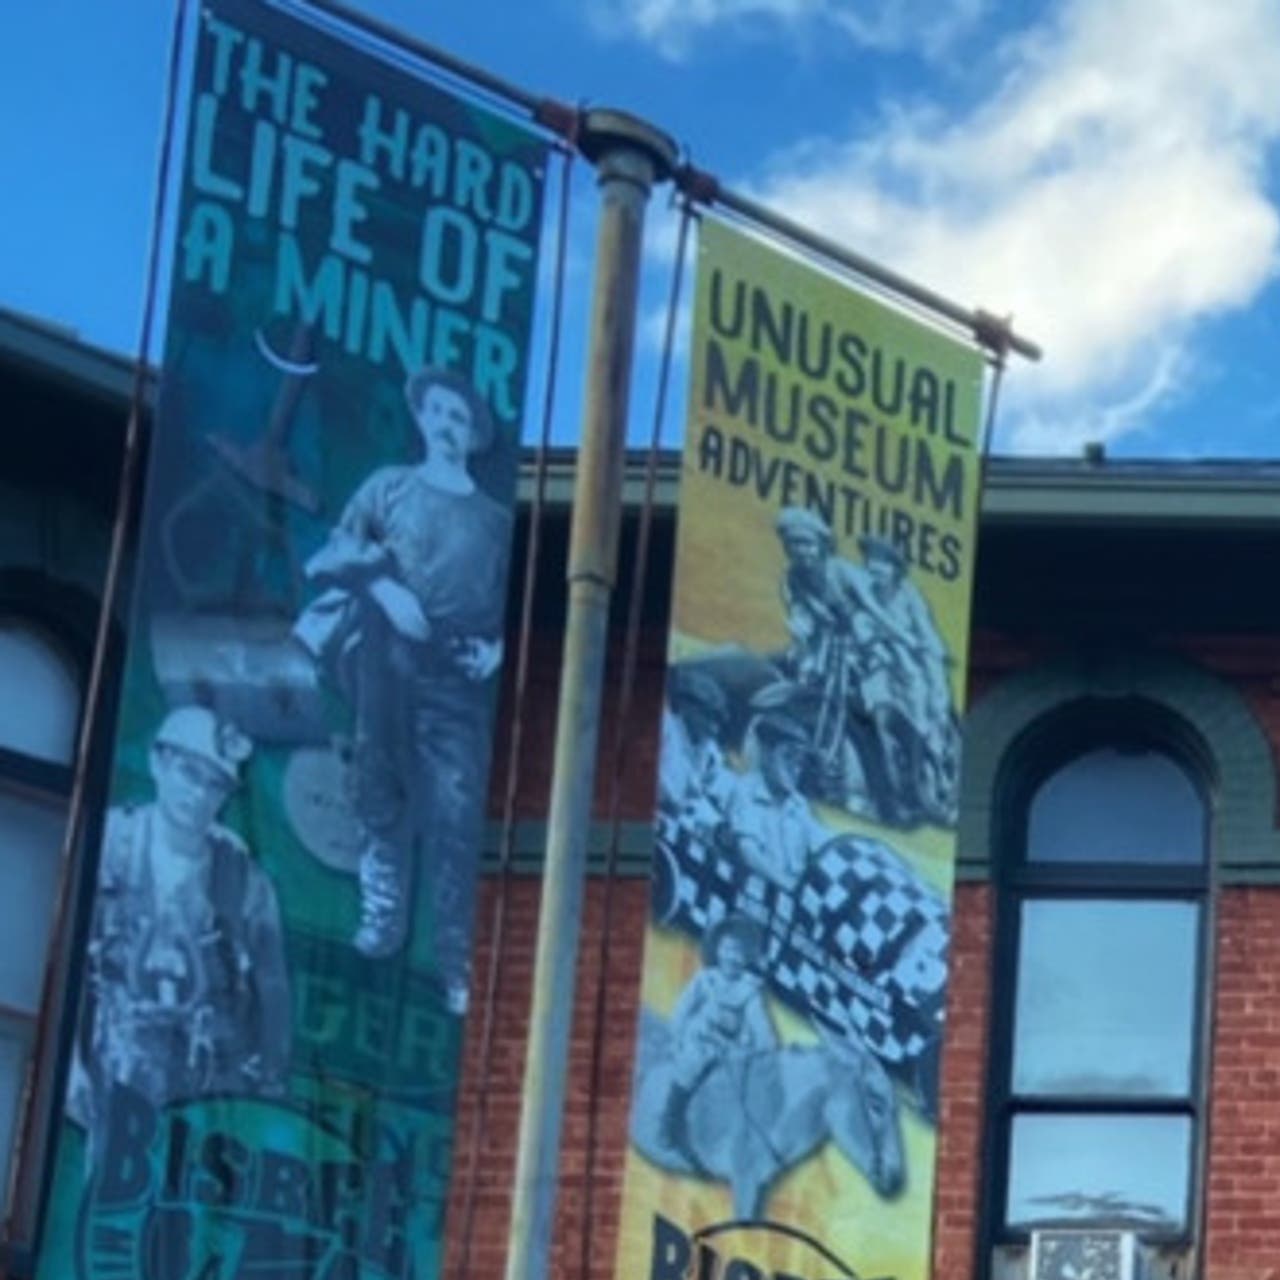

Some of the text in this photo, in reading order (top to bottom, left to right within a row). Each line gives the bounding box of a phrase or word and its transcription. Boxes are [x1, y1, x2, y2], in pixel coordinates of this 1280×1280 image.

[193, 93, 534, 321] LIFE OF
[206, 17, 534, 231] THE HARD
[182, 204, 520, 420] A MINER
[708, 268, 971, 448] UNUSUAL
[697, 424, 961, 582] ADVENTURES
[704, 340, 965, 520] MUSEUM
